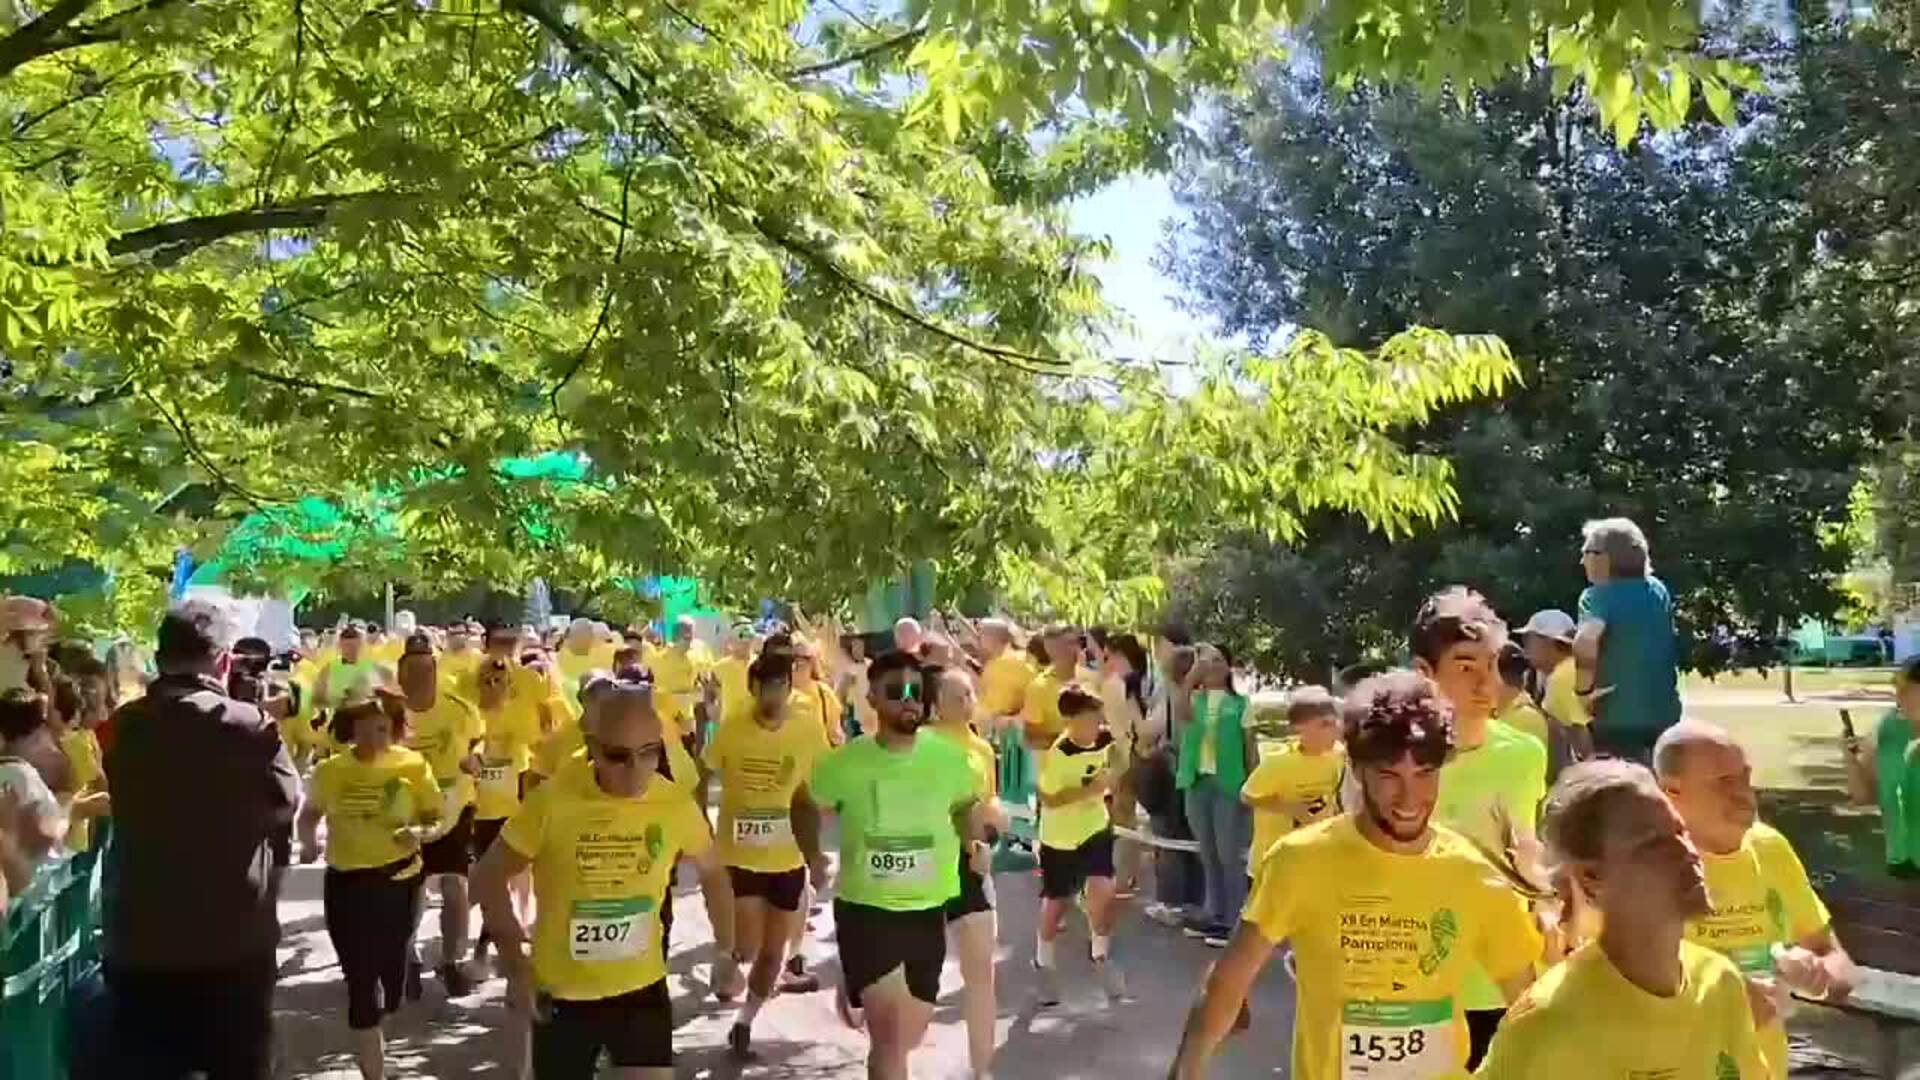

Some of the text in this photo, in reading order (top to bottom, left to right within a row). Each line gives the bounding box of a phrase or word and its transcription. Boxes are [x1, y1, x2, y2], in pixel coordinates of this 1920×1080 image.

[871, 854, 916, 872] 0891
[1360, 914, 1377, 928] En
[575, 922, 631, 942] 2107
[1340, 935, 1418, 952] Pamplona
[1350, 1029, 1425, 1062] 1538
